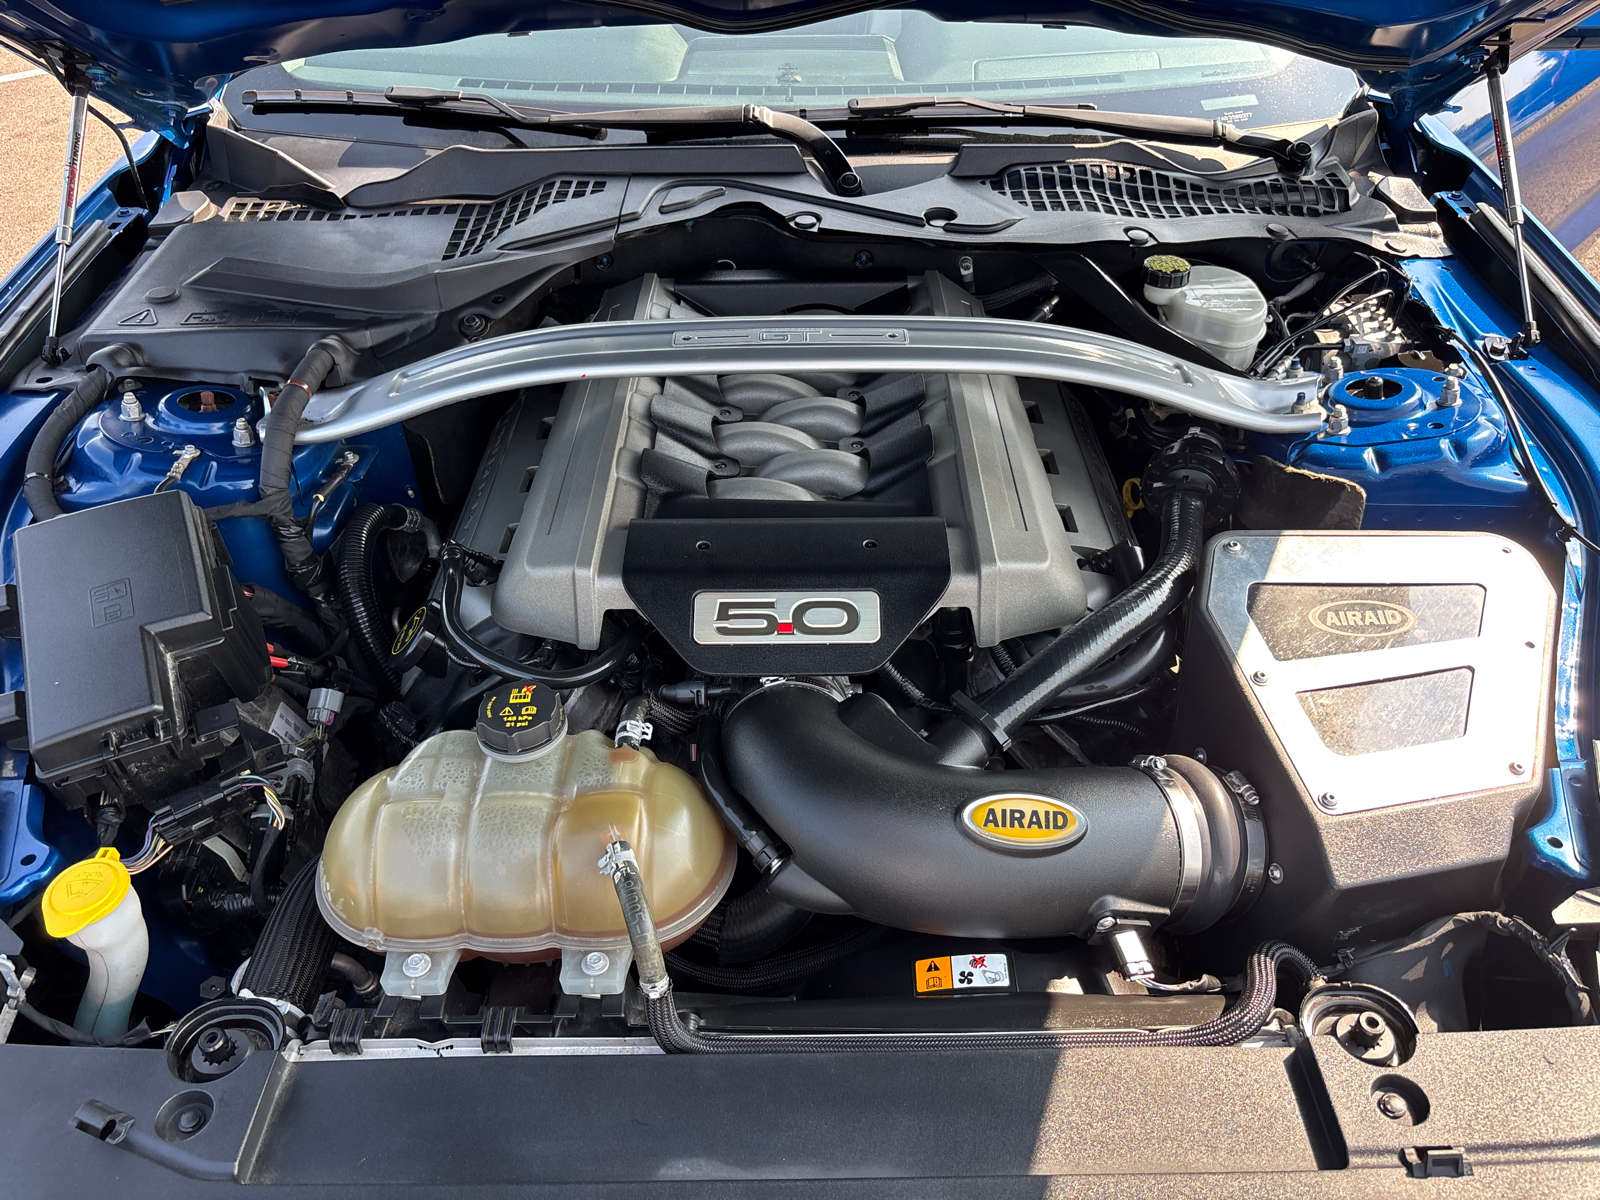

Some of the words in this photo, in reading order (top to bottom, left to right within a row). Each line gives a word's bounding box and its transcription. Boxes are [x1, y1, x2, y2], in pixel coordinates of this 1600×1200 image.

[71, 131, 82, 167] TUNING
[758, 329, 823, 343] GT
[713, 597, 861, 636] 5.0
[1326, 609, 1402, 626] AIRAID
[983, 808, 1069, 830] AIRAID
